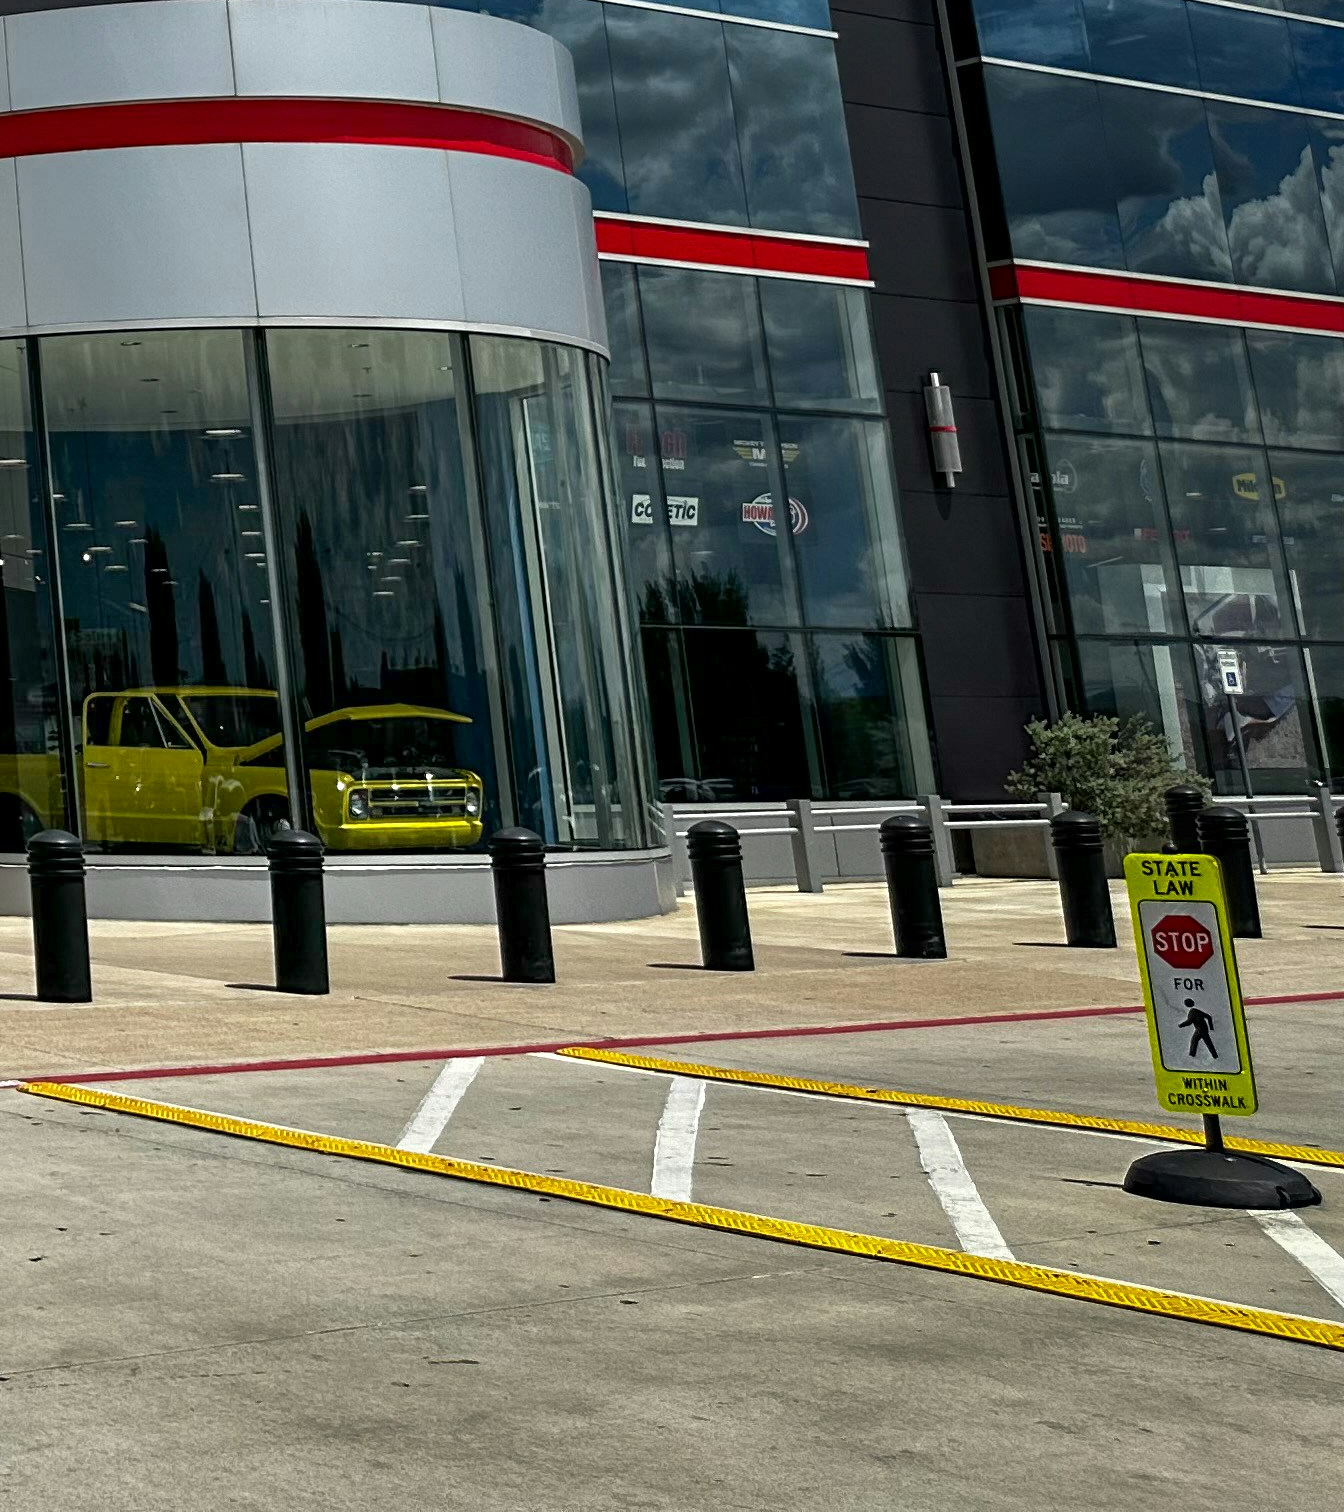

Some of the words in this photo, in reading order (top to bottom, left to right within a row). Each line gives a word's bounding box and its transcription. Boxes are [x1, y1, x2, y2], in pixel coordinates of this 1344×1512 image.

[634, 501, 696, 520] COETIC
[1141, 860, 1202, 877] STATE
[1153, 879, 1194, 896] LAW
[1155, 931, 1210, 953] STOP
[1173, 977, 1205, 991] FOR
[1181, 1076, 1228, 1092] WITHIN
[1167, 1091, 1247, 1109] CROSSWALK
